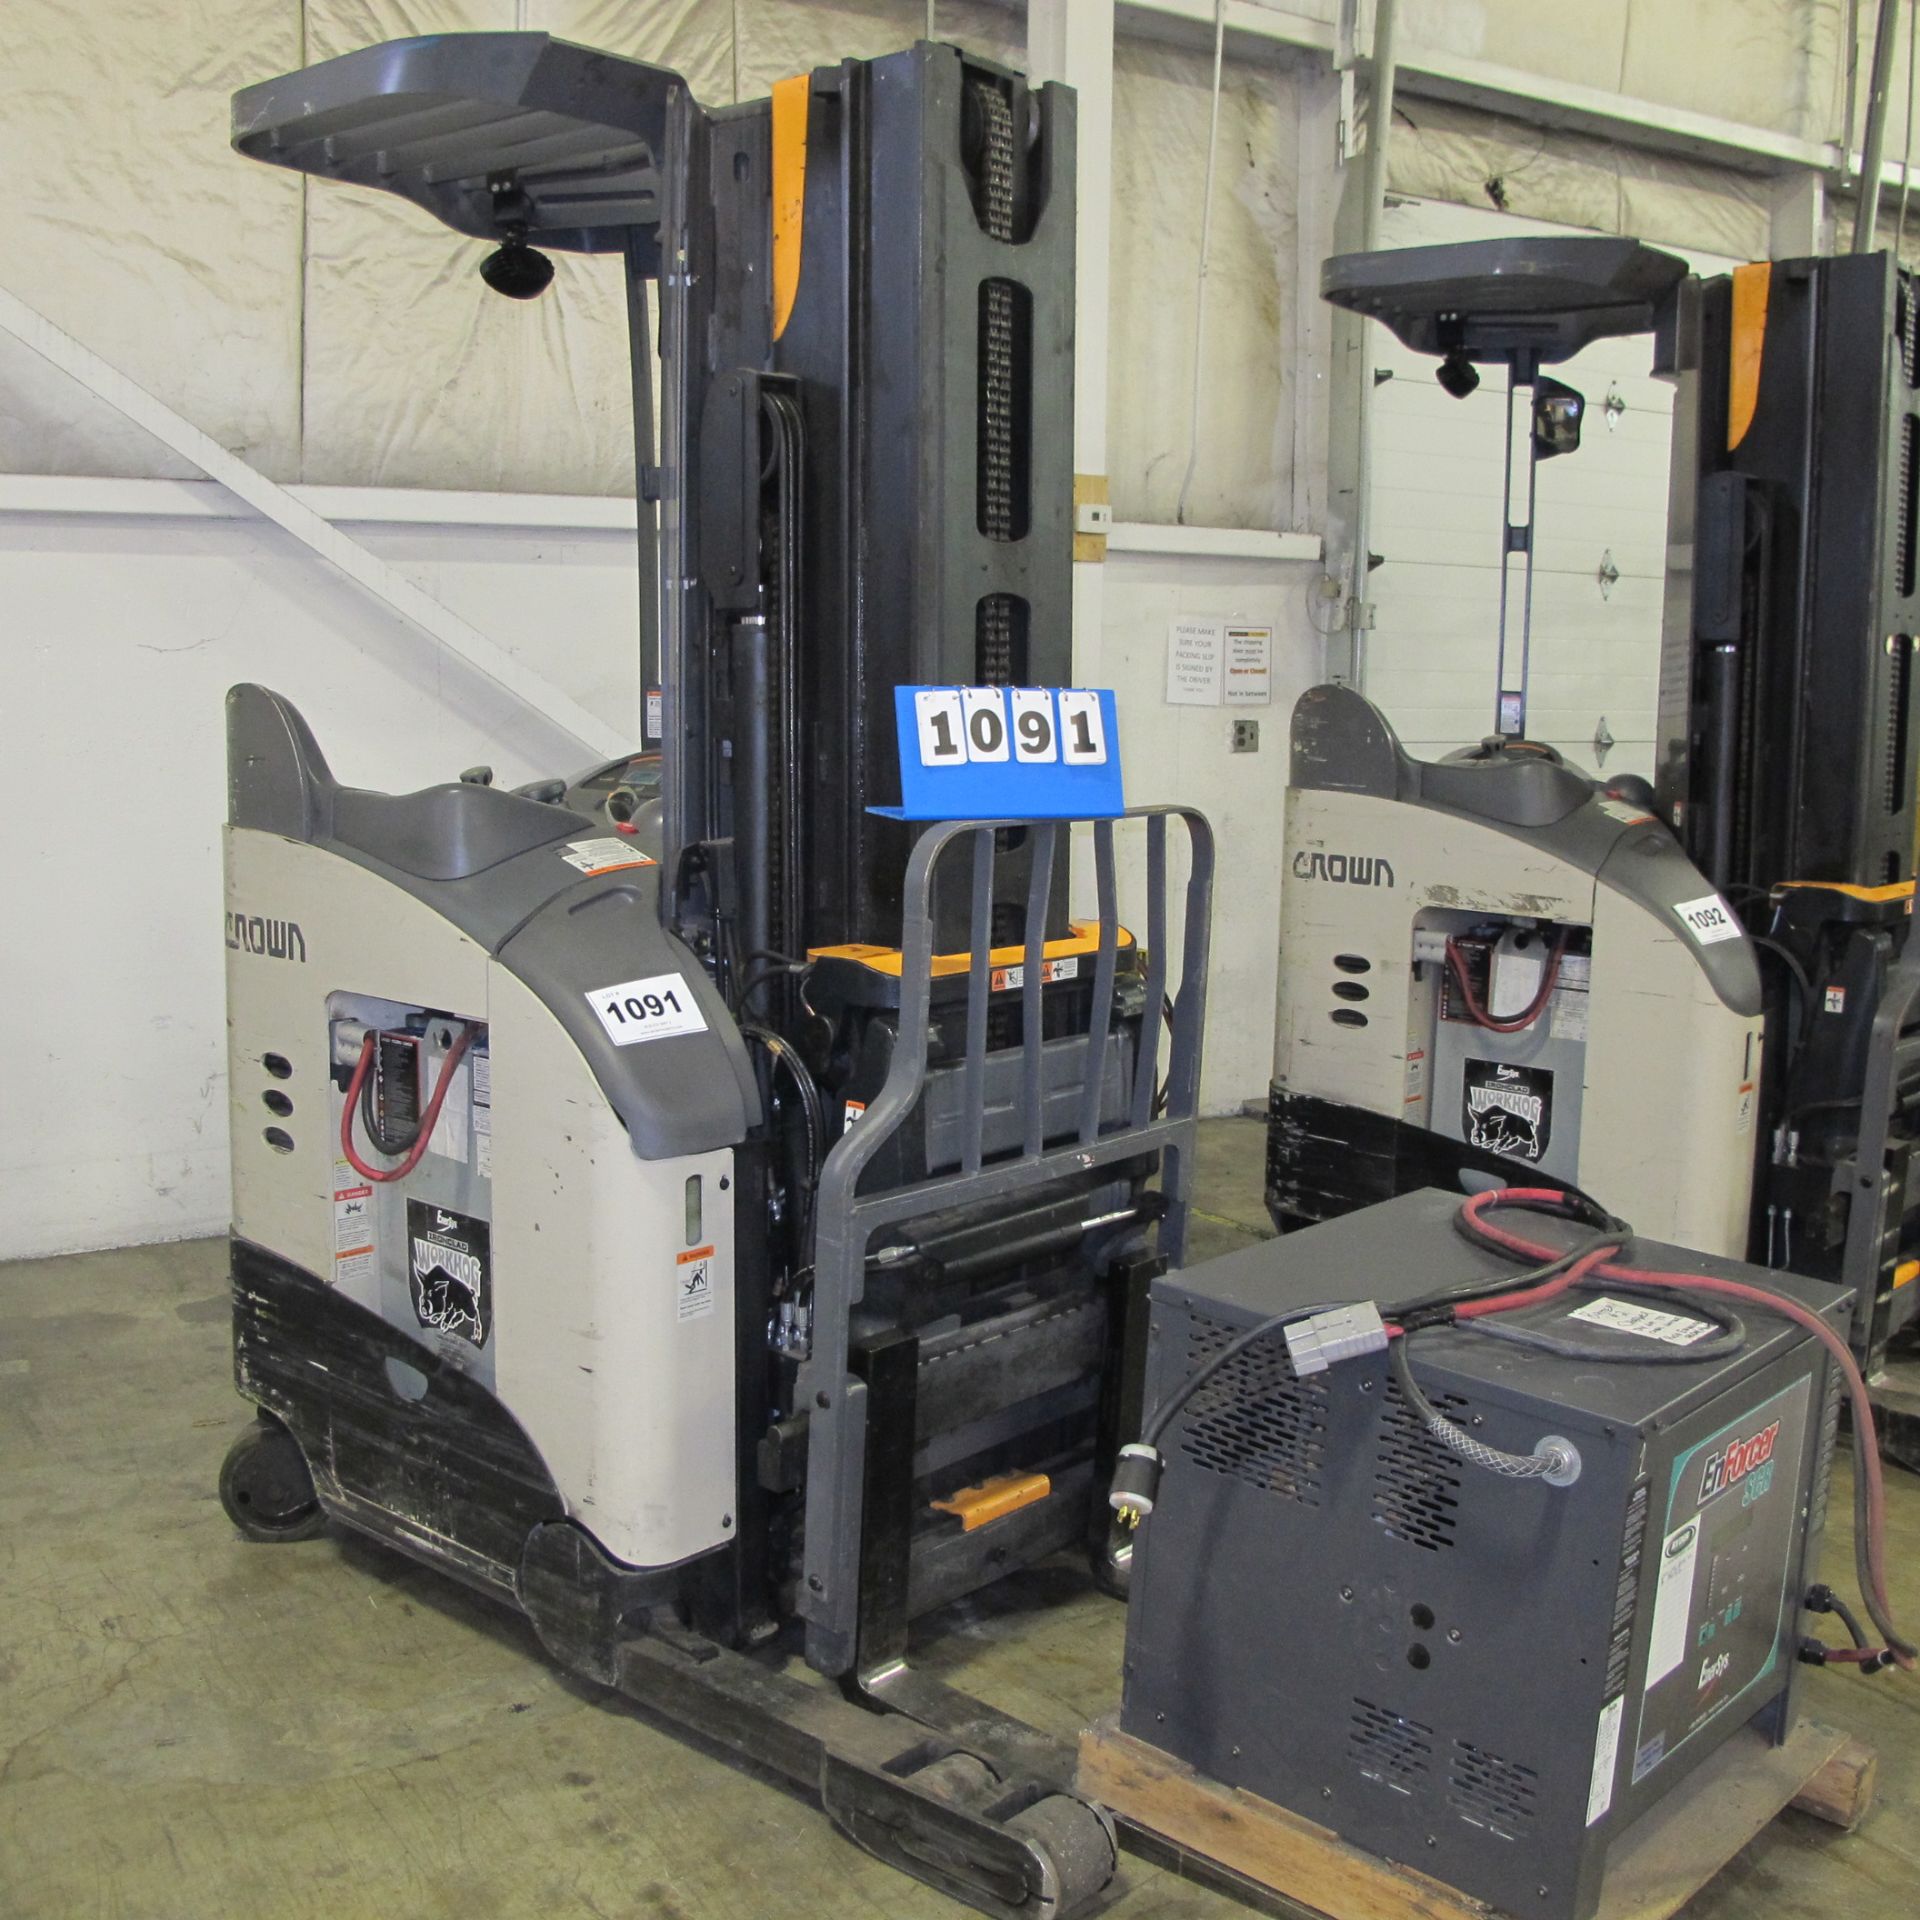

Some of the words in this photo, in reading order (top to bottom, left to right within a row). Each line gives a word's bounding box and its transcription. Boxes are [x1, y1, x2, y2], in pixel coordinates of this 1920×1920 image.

[1176, 650, 1201, 660] PACKING
[1182, 665, 1204, 673] SIGNED
[1177, 675, 1188, 683] THE
[1189, 676, 1211, 684] DRIVER
[930, 708, 1097, 756] 1091
[1293, 851, 1394, 888] CROWN
[1688, 907, 1726, 930] 1092
[607, 990, 682, 1023] 1091
[1470, 1086, 1542, 1126] WORKHOG
[413, 1237, 481, 1298] WORKHOG
[1697, 1419, 1780, 1507] EnForcer
[1698, 1652, 1730, 1690] EnerSys
